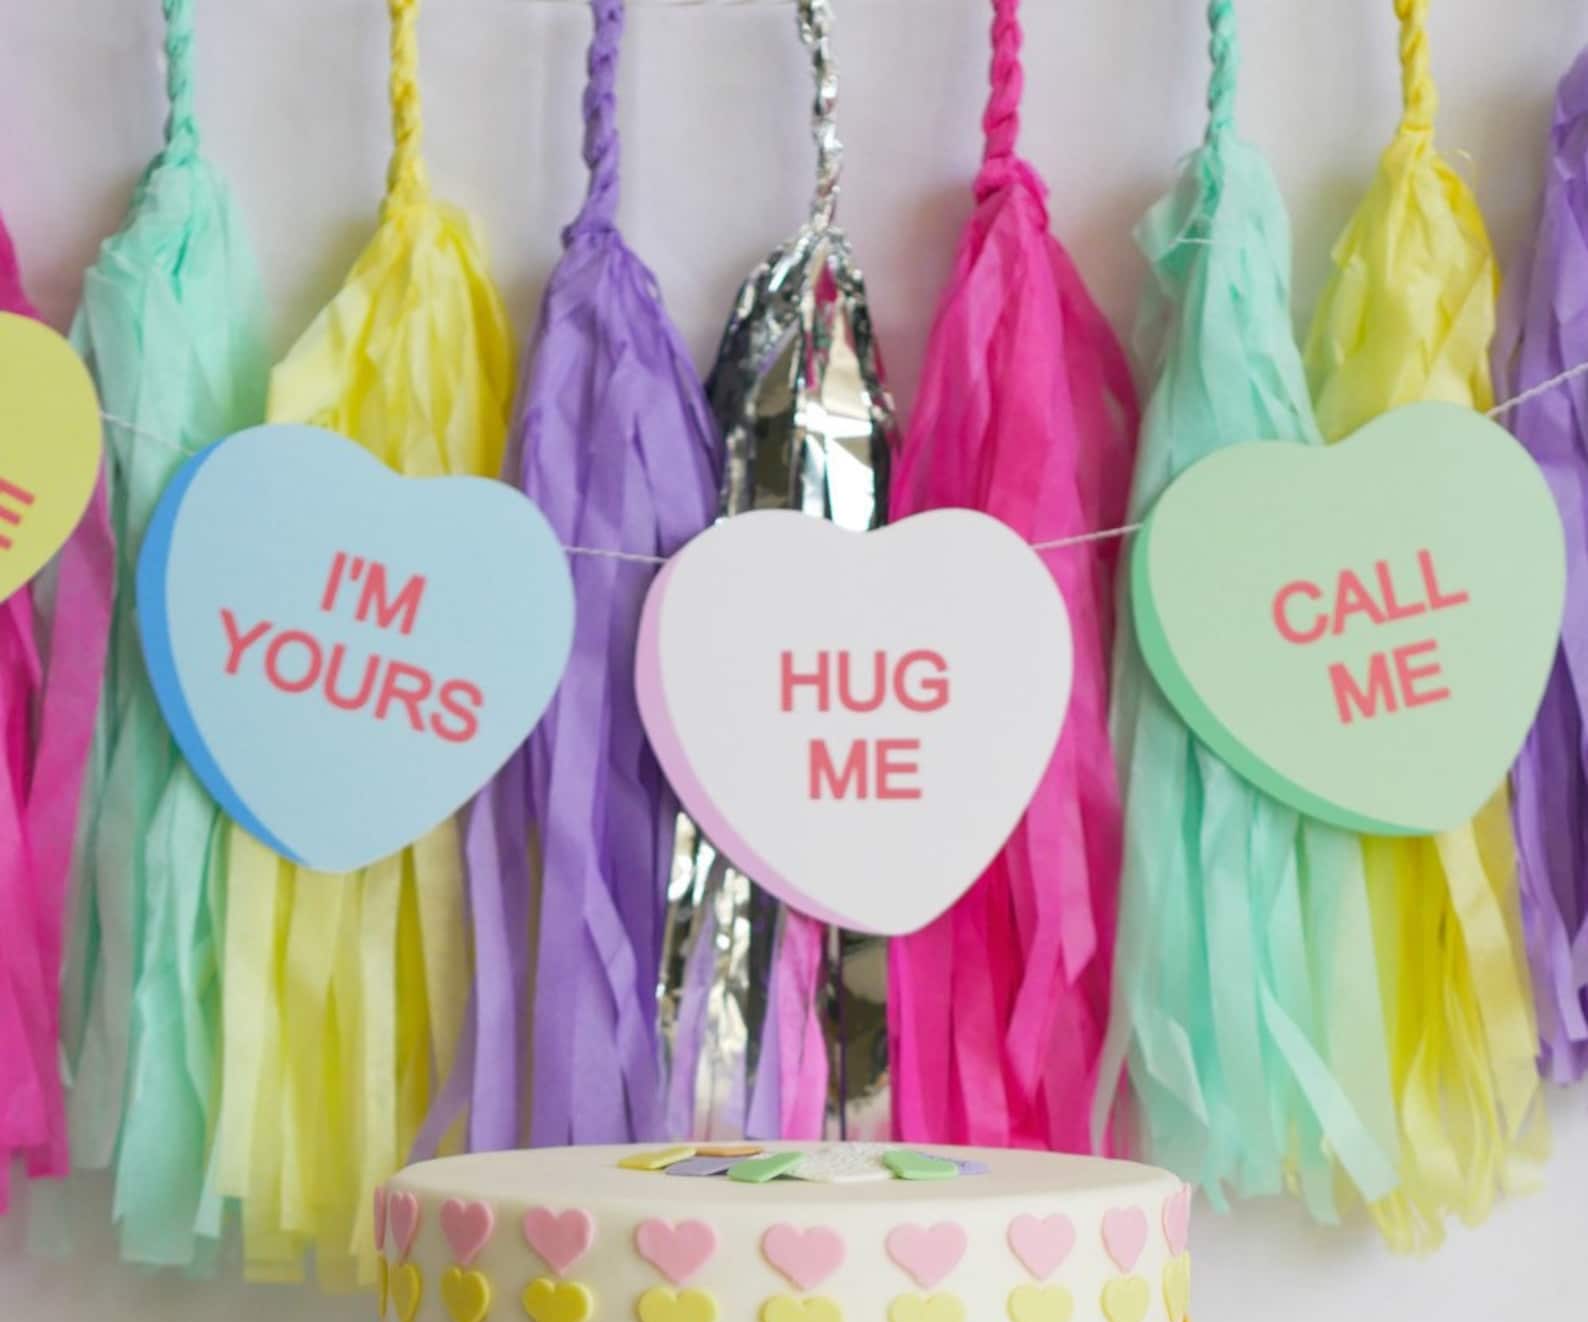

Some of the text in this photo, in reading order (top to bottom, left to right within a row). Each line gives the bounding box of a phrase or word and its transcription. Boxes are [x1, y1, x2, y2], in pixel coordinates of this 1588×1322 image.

[320, 551, 427, 635] I'M
[1272, 549, 1469, 645] CALL
[219, 608, 486, 743] YOURS
[779, 649, 951, 714] HUG
[1329, 639, 1450, 724] ME
[808, 738, 922, 801] ME
